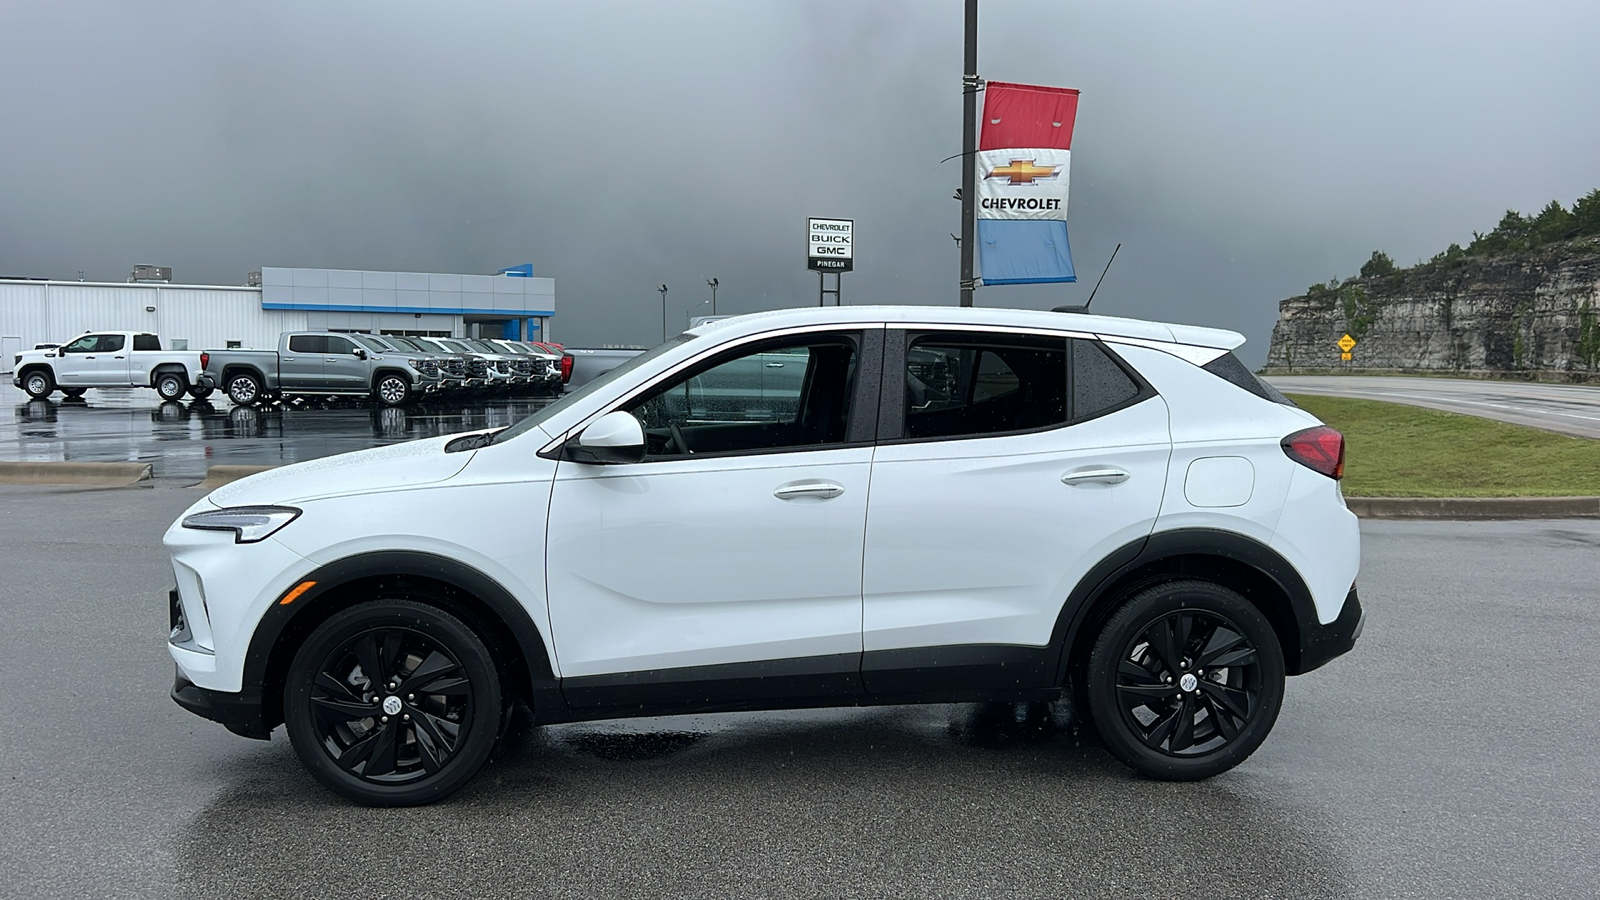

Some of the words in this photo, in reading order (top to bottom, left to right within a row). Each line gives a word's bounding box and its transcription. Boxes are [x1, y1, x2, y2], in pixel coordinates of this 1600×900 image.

[982, 197, 1061, 210] CHEVROLET
[812, 223, 850, 232] CHEVROLET
[811, 234, 850, 244] BUICK
[817, 246, 845, 255] GMC
[817, 260, 845, 268] PINEGAR
